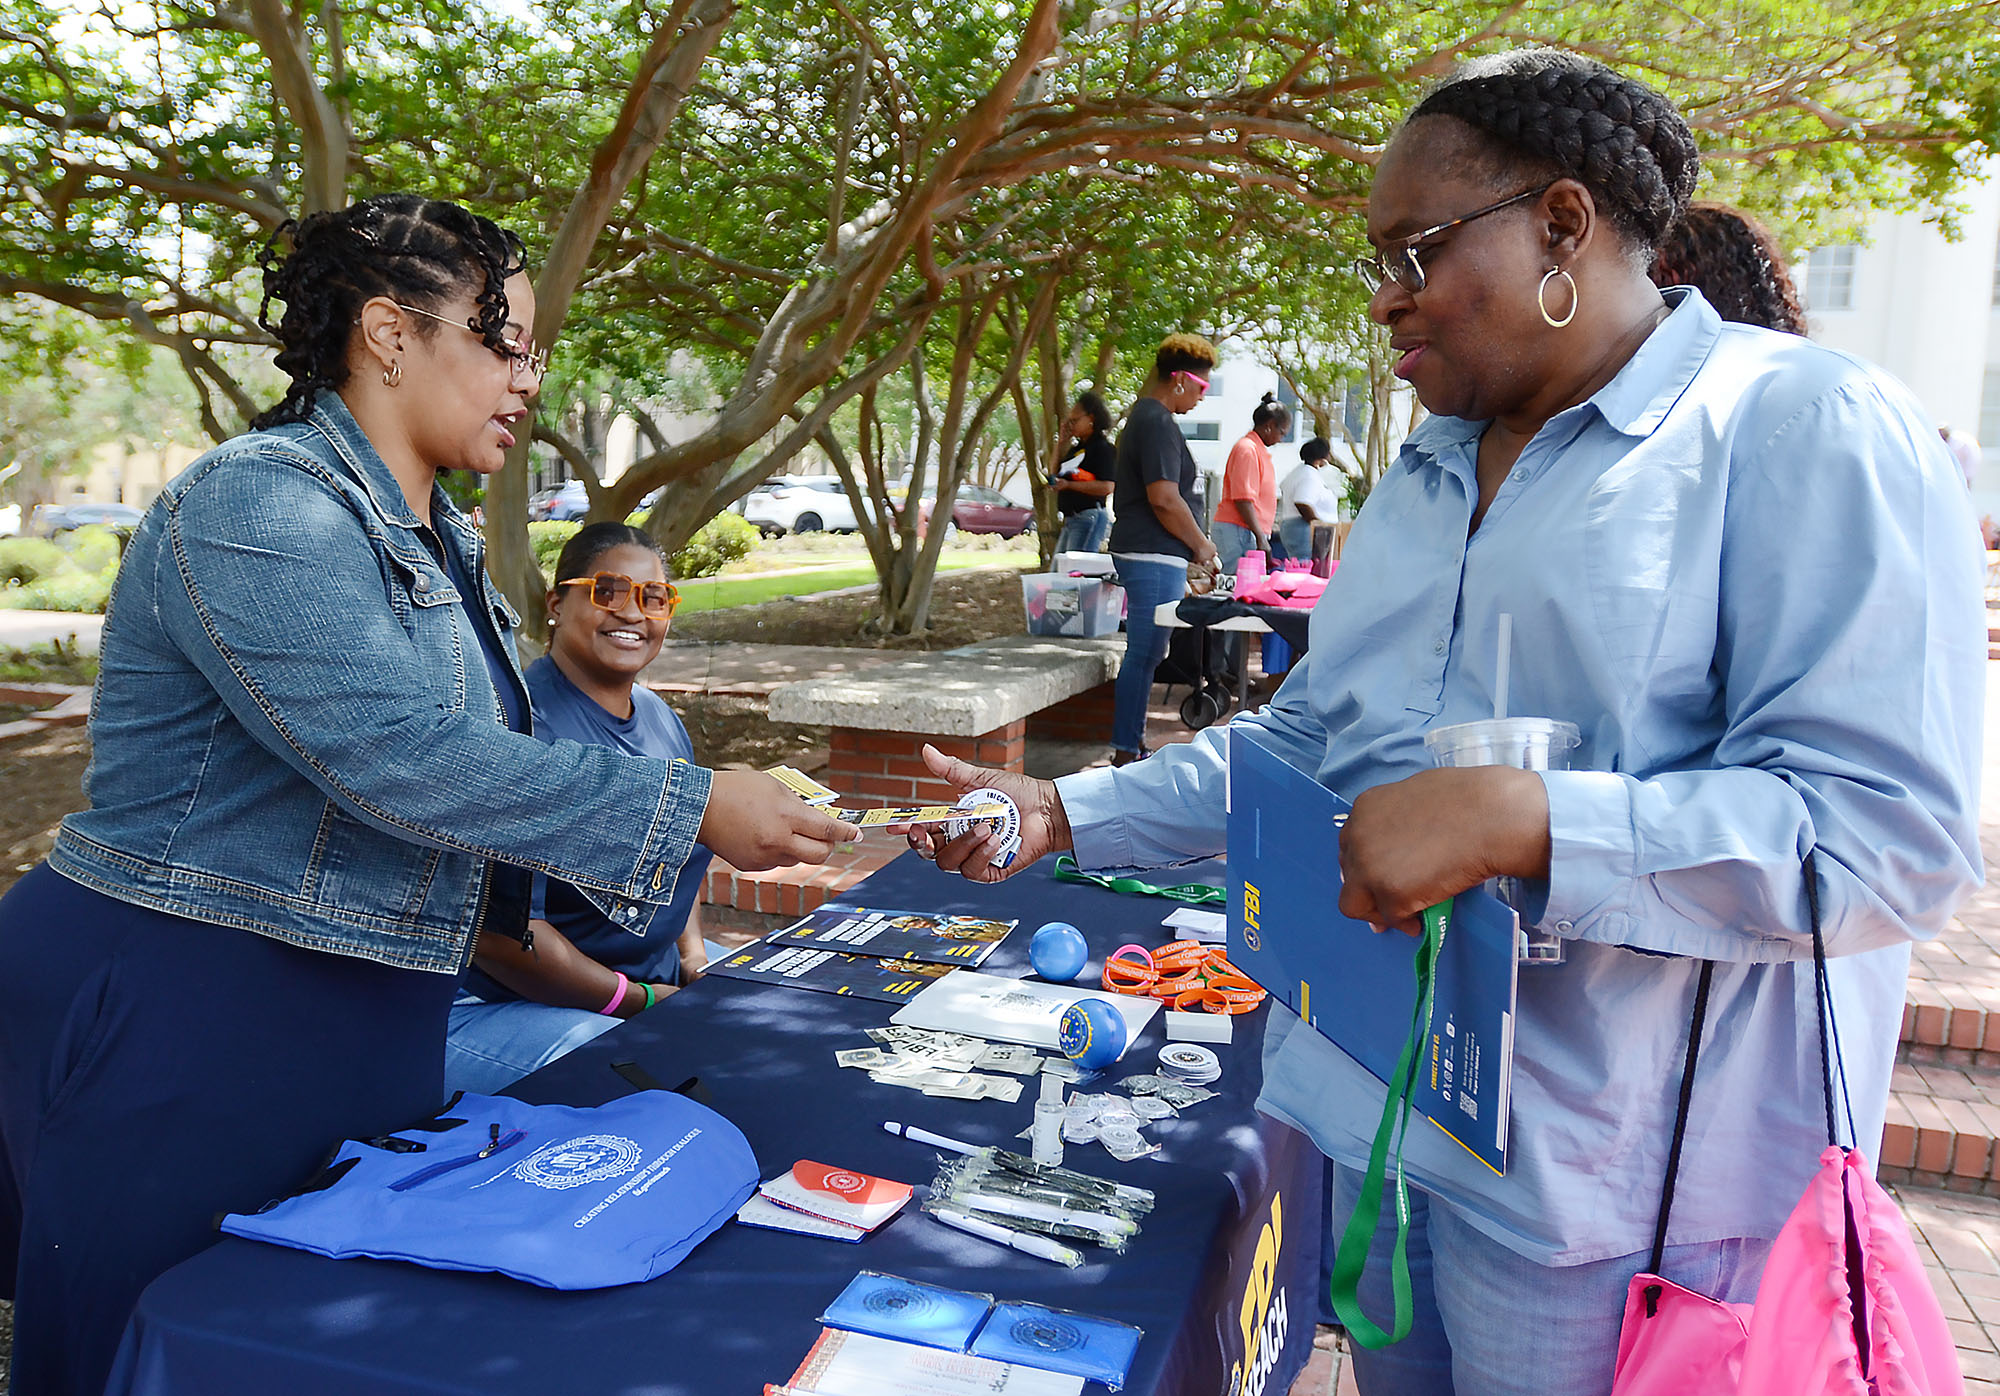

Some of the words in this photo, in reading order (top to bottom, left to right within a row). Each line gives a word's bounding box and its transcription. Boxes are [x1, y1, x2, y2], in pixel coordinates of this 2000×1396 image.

[1243, 880, 1261, 930] FBI
[574, 1201, 609, 1227] CREATING
[604, 1168, 651, 1204] RELATIONSHIPS
[647, 1148, 677, 1172] THROUGH
[672, 1128, 702, 1151] DIALOGUE
